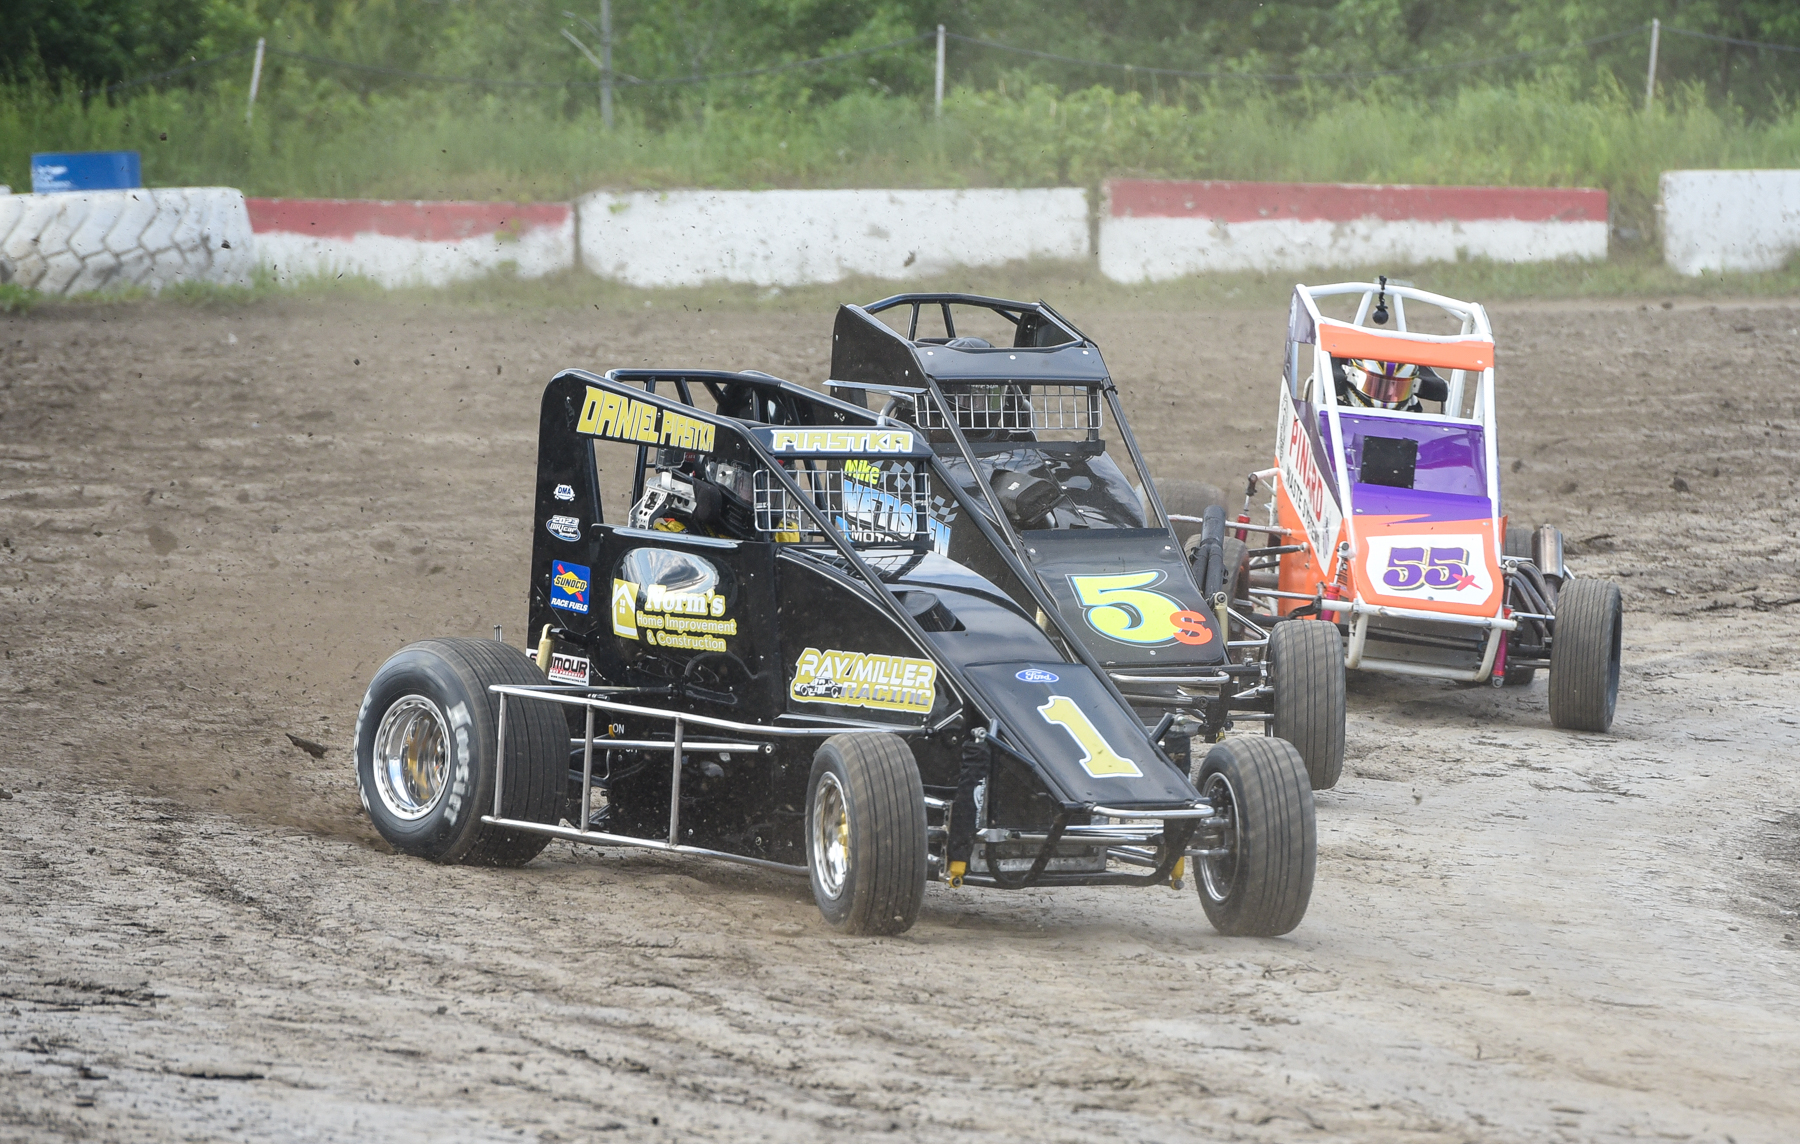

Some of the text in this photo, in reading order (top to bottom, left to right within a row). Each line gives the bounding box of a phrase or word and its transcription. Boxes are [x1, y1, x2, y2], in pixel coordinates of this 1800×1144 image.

[576, 385, 716, 453] DANIEL PIASTKA
[772, 430, 912, 453] PIASTKA
[844, 459, 880, 485] Mike
[557, 486, 571, 495] DMA
[555, 576, 587, 591] SUNOCO
[551, 597, 589, 612] RACE FUELS
[646, 585, 724, 616] Norm's
[637, 612, 736, 633] Home Improvement
[646, 632, 725, 650] & Construction
[800, 653, 933, 688] RAY MILLER
[840, 681, 932, 707] RACING
[613, 723, 625, 734] ON
[1037, 695, 1144, 778] 1
